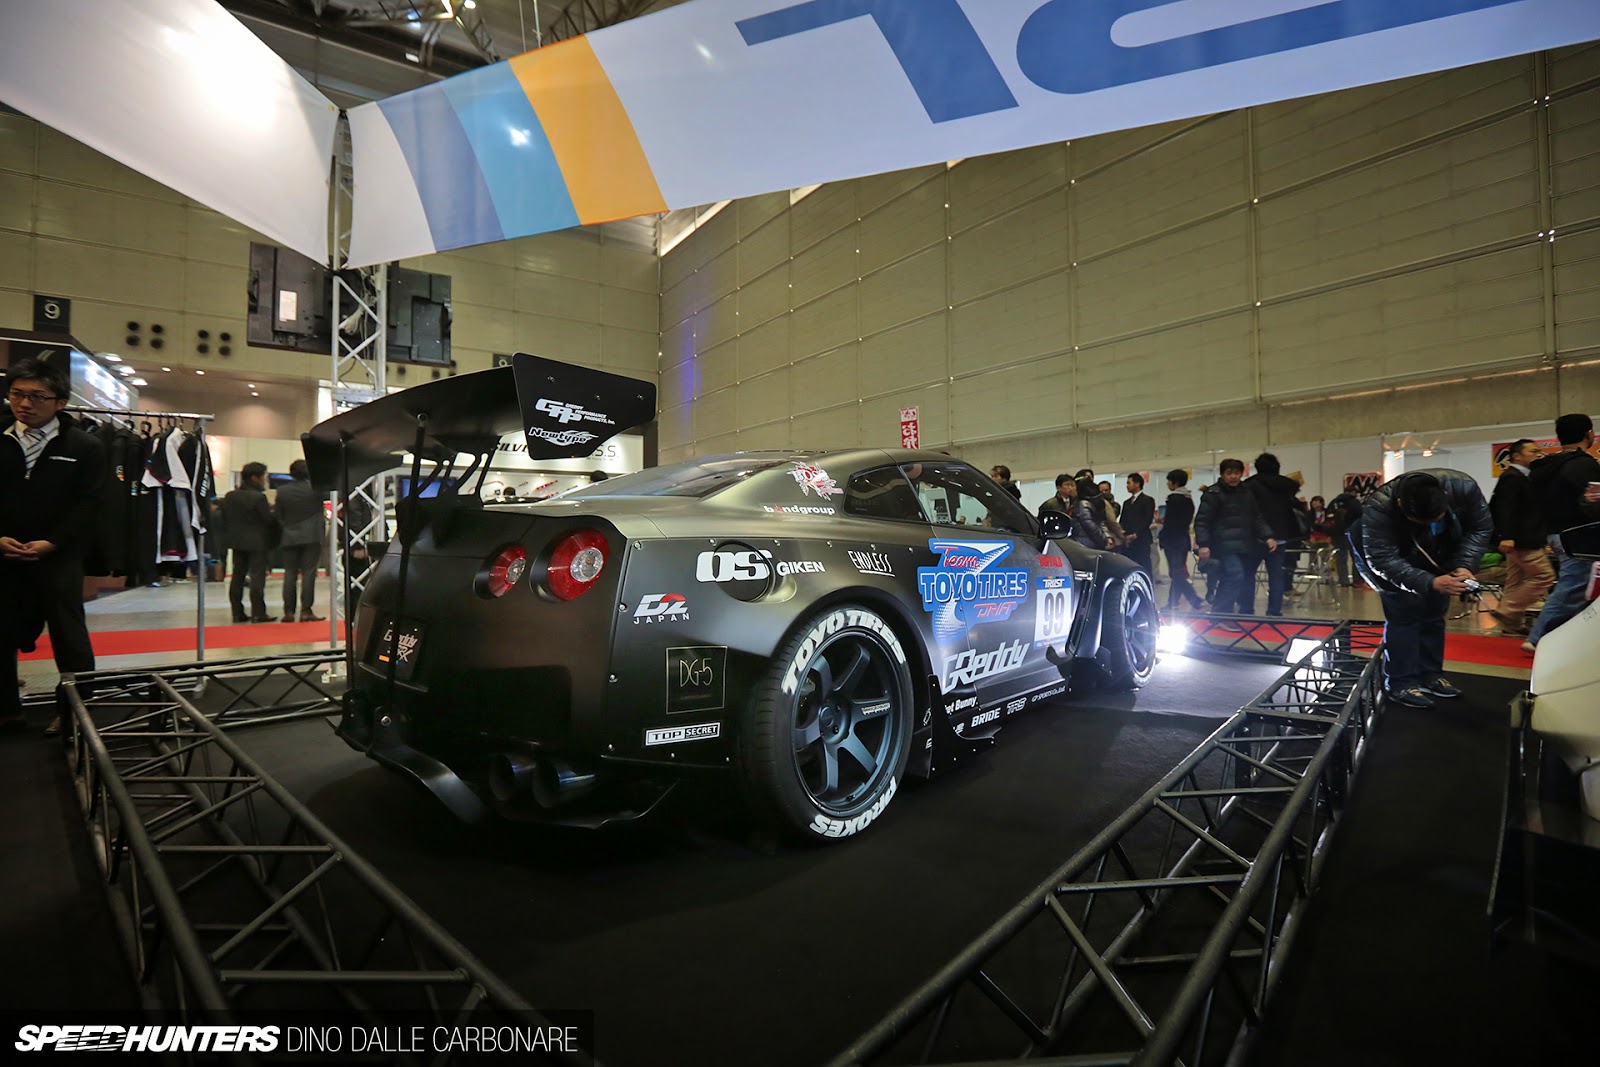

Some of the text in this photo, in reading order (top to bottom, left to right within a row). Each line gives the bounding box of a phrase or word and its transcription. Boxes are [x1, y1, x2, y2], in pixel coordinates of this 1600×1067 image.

[44, 302, 60, 320] 9
[528, 426, 589, 445] Newtype
[695, 549, 826, 583] OS GIKEN
[847, 550, 893, 573] ENDLESS
[934, 545, 981, 569] Team
[1042, 578, 1066, 589] TRUST
[633, 612, 690, 625] JAPAN
[973, 601, 1017, 618] DRIFT
[1043, 591, 1065, 637] 99
[780, 609, 907, 695] TOYO TIRES
[970, 707, 1001, 728] BRIDE
[652, 731, 682, 741] TOP
[685, 725, 718, 736] SECRET
[809, 775, 897, 839] PROXES
